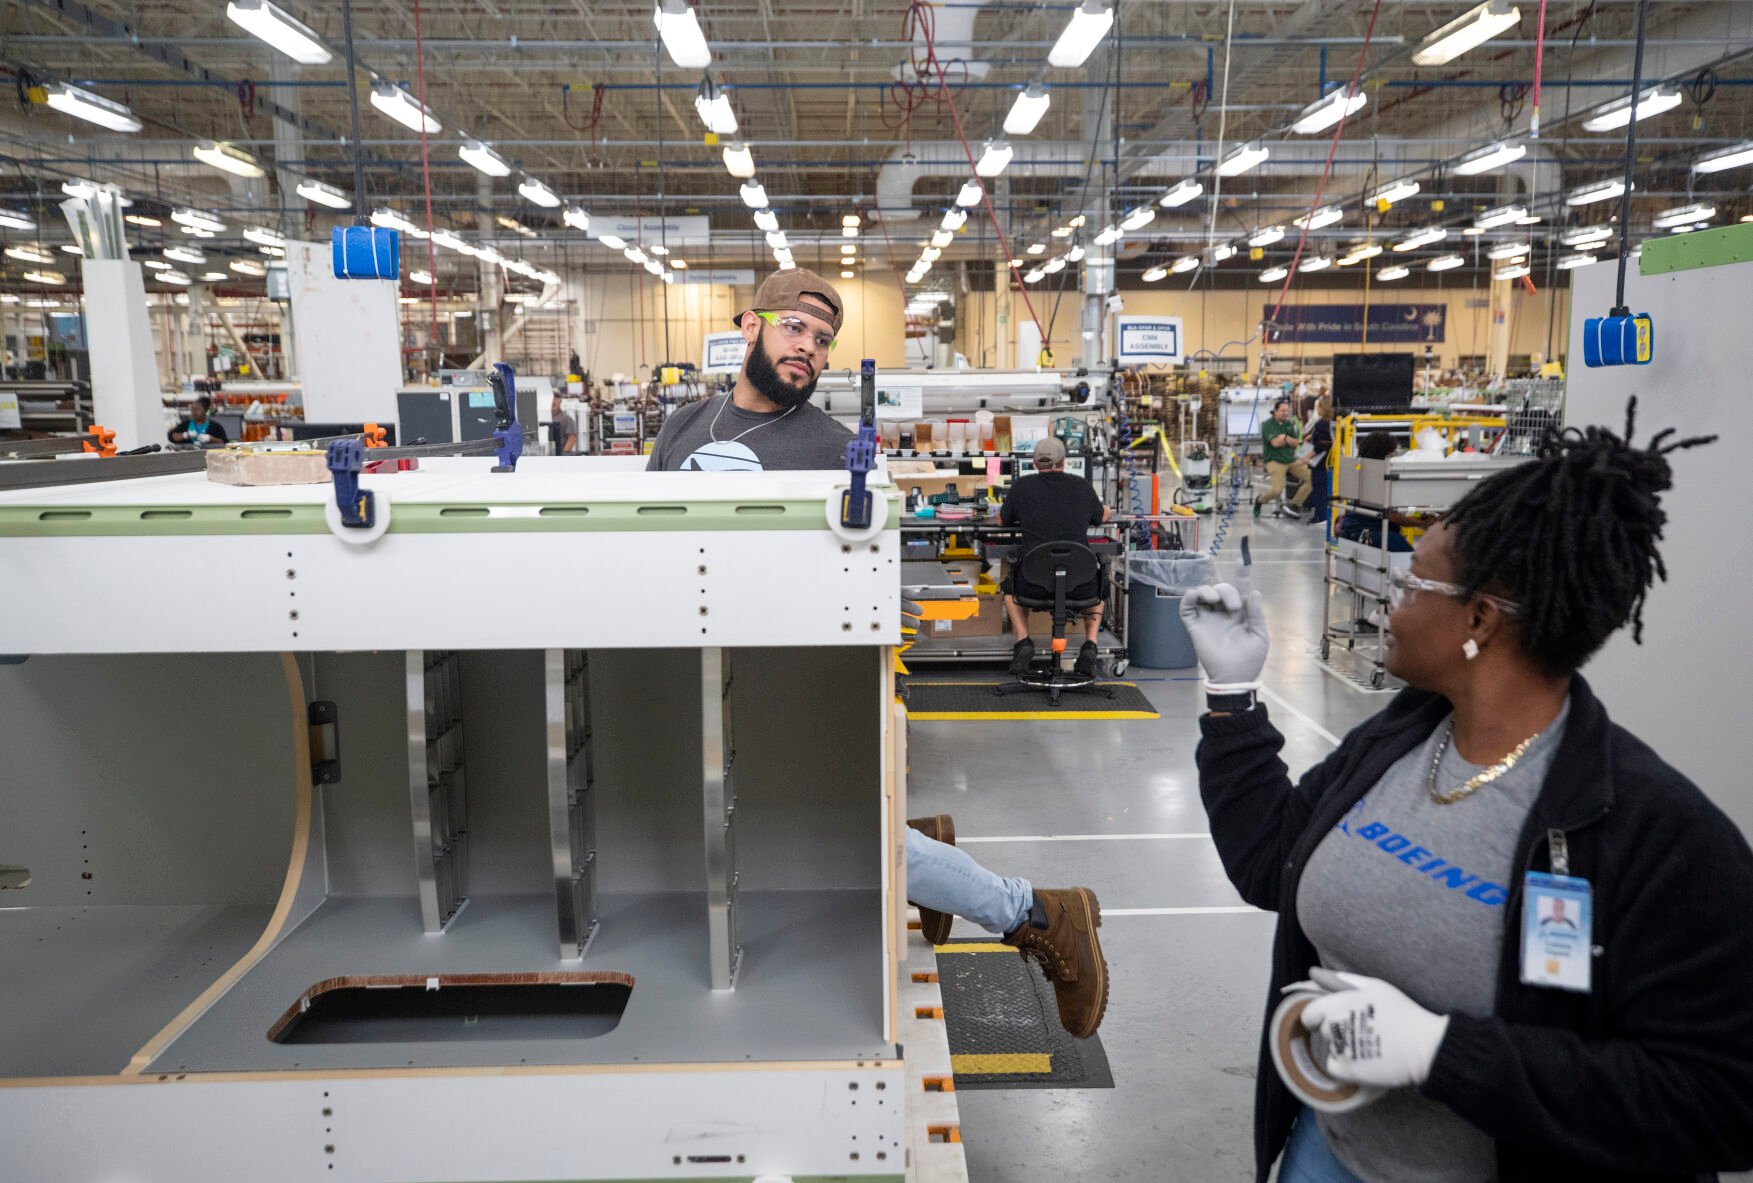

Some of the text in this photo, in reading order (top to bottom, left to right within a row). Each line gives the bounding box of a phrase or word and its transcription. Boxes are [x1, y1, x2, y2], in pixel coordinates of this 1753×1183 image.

[1318, 321, 1342, 331] Pride
[1344, 321, 1352, 331] in
[1130, 342, 1168, 350] ASSEMBLY
[1356, 820, 1510, 906] BOEING
